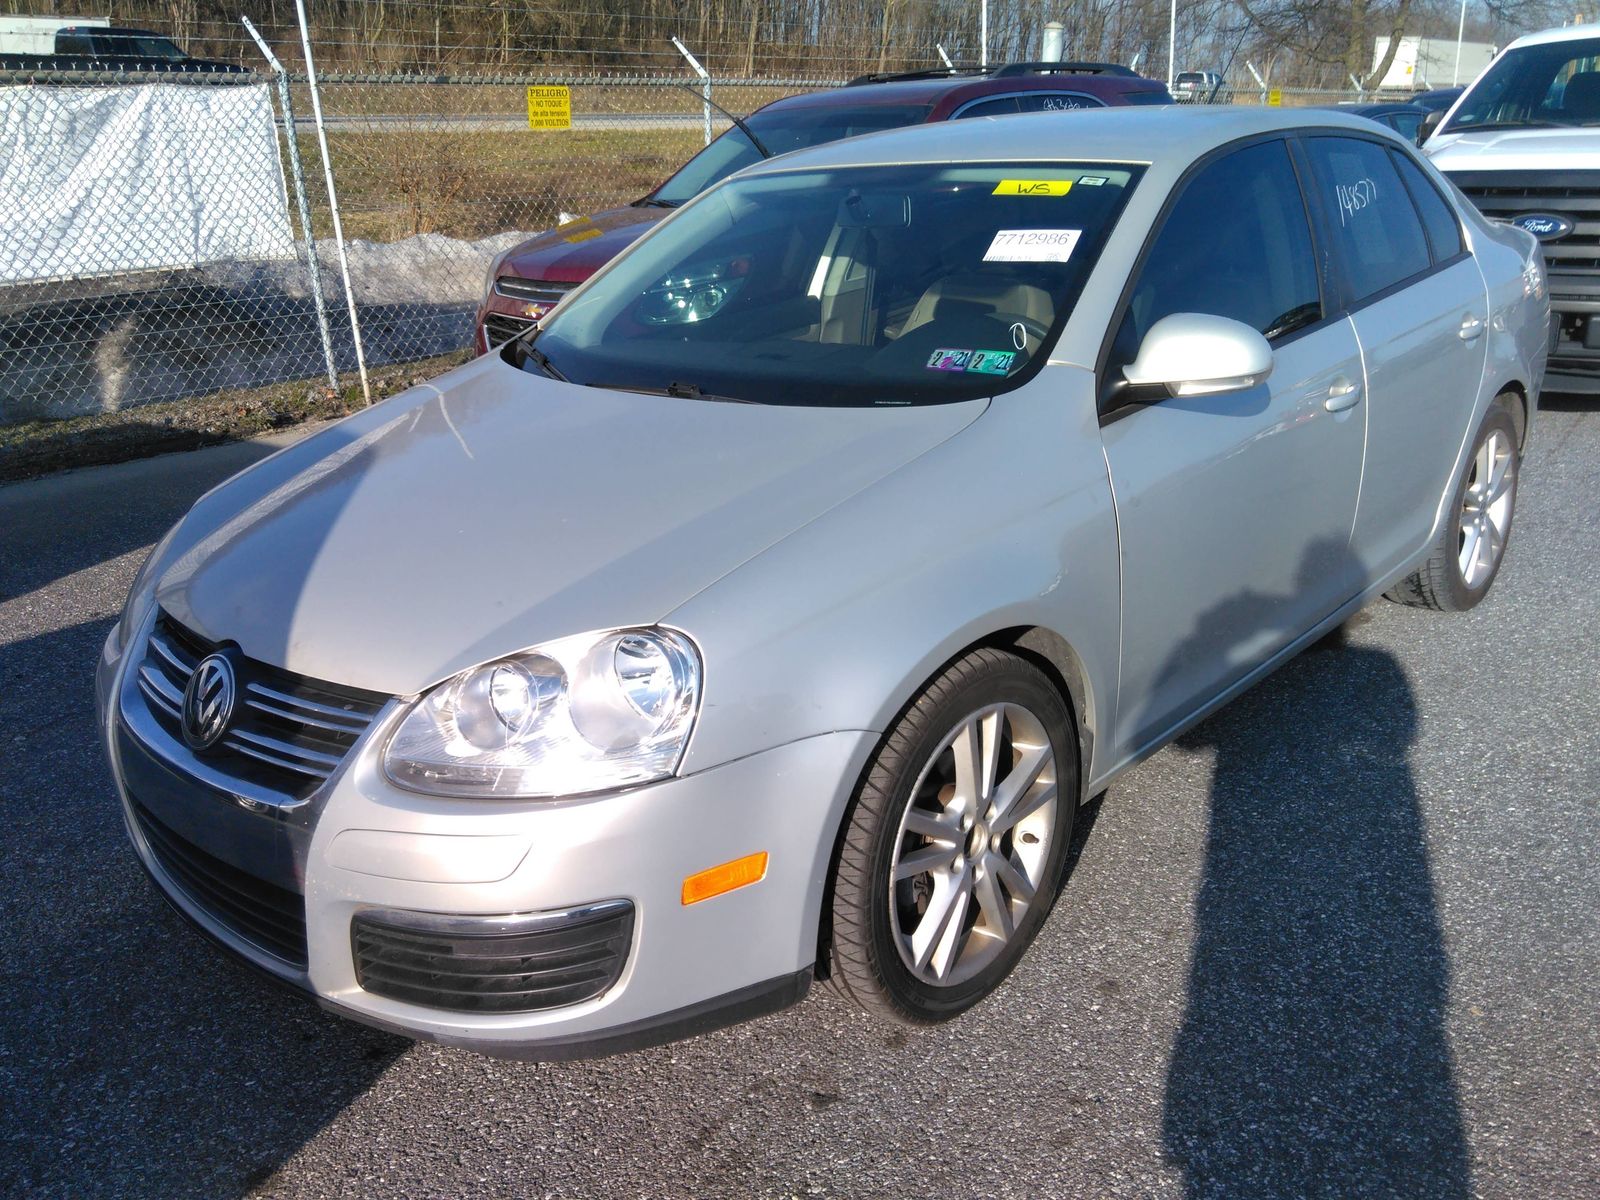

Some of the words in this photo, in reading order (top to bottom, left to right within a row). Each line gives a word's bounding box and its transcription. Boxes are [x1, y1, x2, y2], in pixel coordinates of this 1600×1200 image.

[545, 118, 569, 126] VOLTIOS
[1017, 183, 1050, 194] WS
[1522, 219, 1553, 232] Ford
[995, 233, 1070, 246] 7712986
[954, 351, 970, 367] 21
[996, 354, 1011, 370] 21
